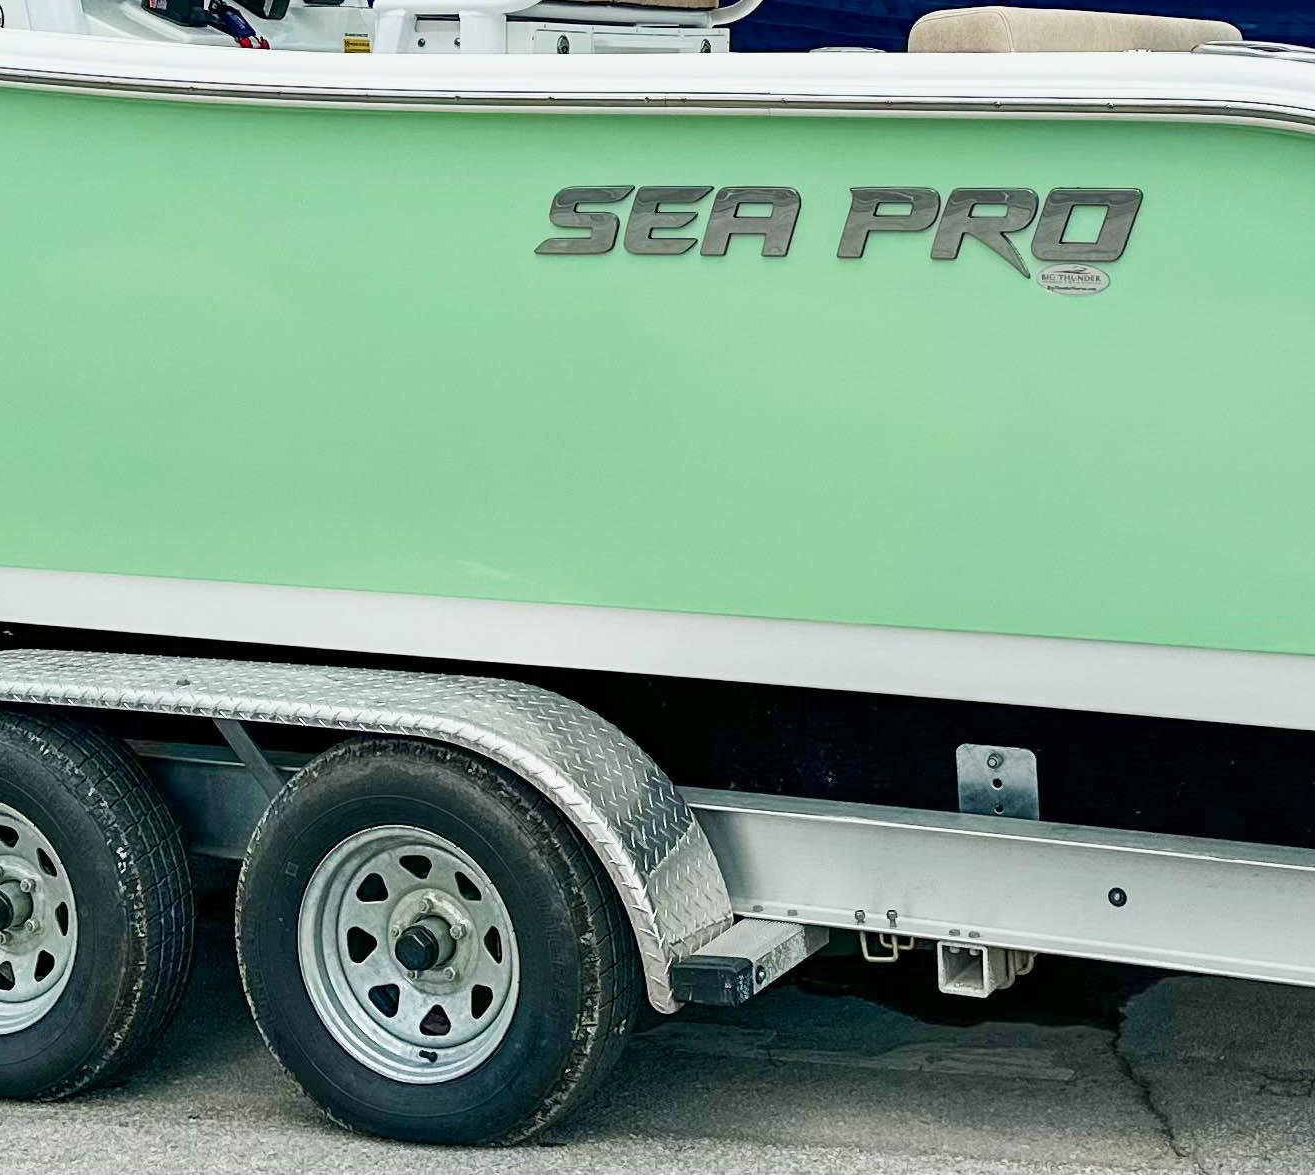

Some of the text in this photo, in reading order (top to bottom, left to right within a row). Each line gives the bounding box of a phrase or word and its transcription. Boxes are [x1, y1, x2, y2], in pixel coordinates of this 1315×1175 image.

[533, 184, 1145, 279] SEA PRO
[1058, 274, 1102, 282] THUNDER
